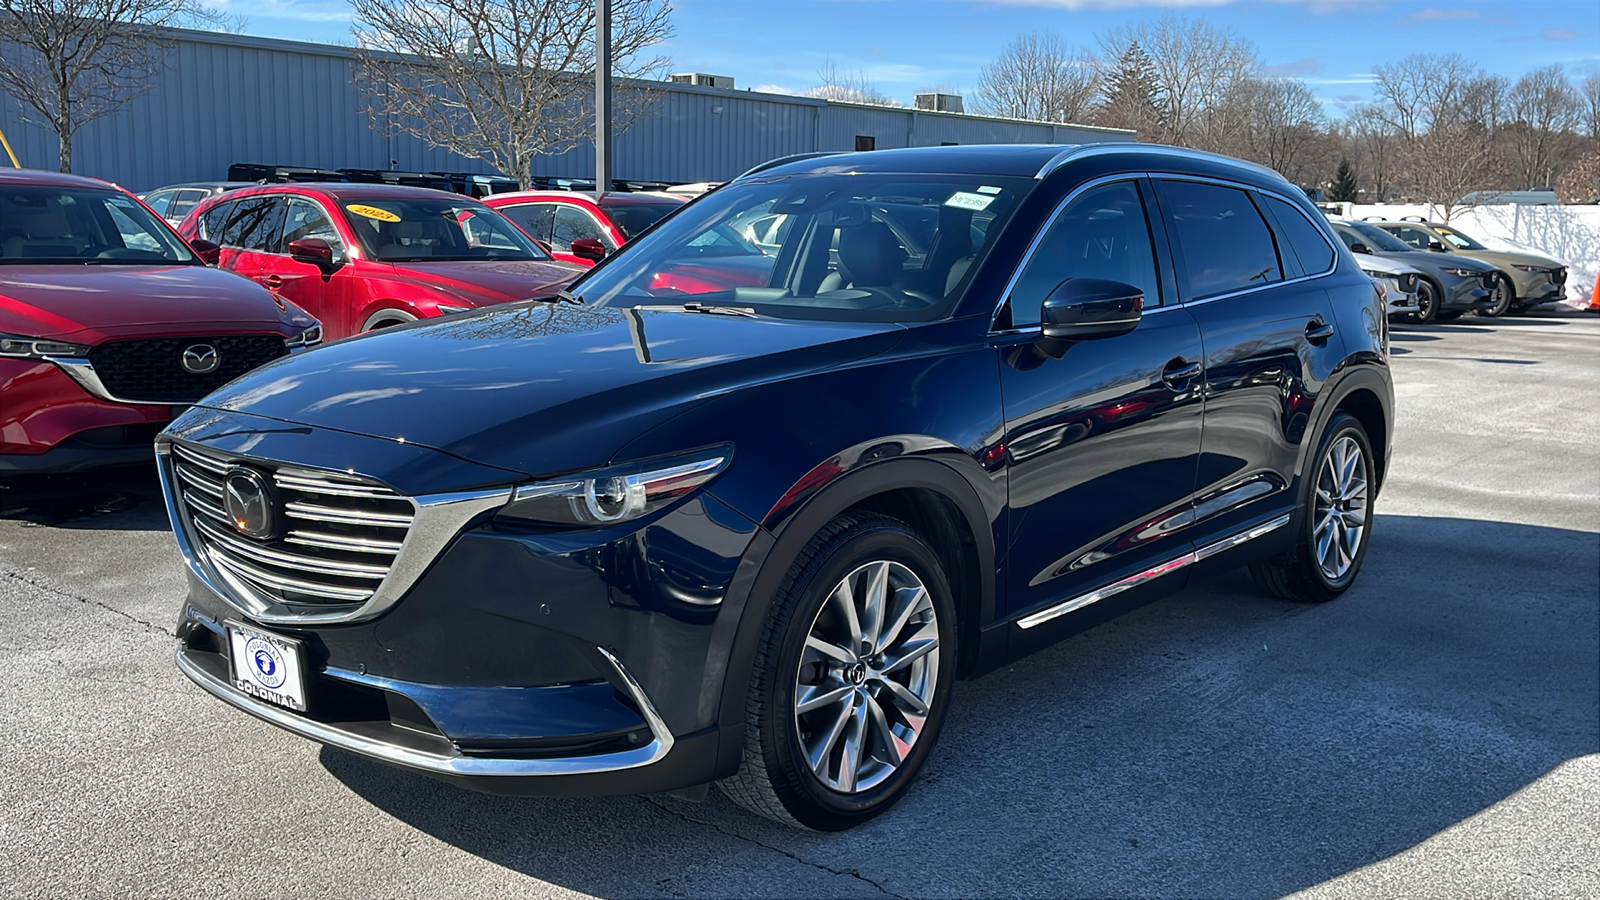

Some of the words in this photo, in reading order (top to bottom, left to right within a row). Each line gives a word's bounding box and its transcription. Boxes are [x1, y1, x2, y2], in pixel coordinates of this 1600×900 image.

[355, 206, 394, 219] 2023
[249, 641, 280, 663] COLONIAL
[256, 669, 280, 685] MAZDA
[236, 680, 297, 710] COLONIAL
